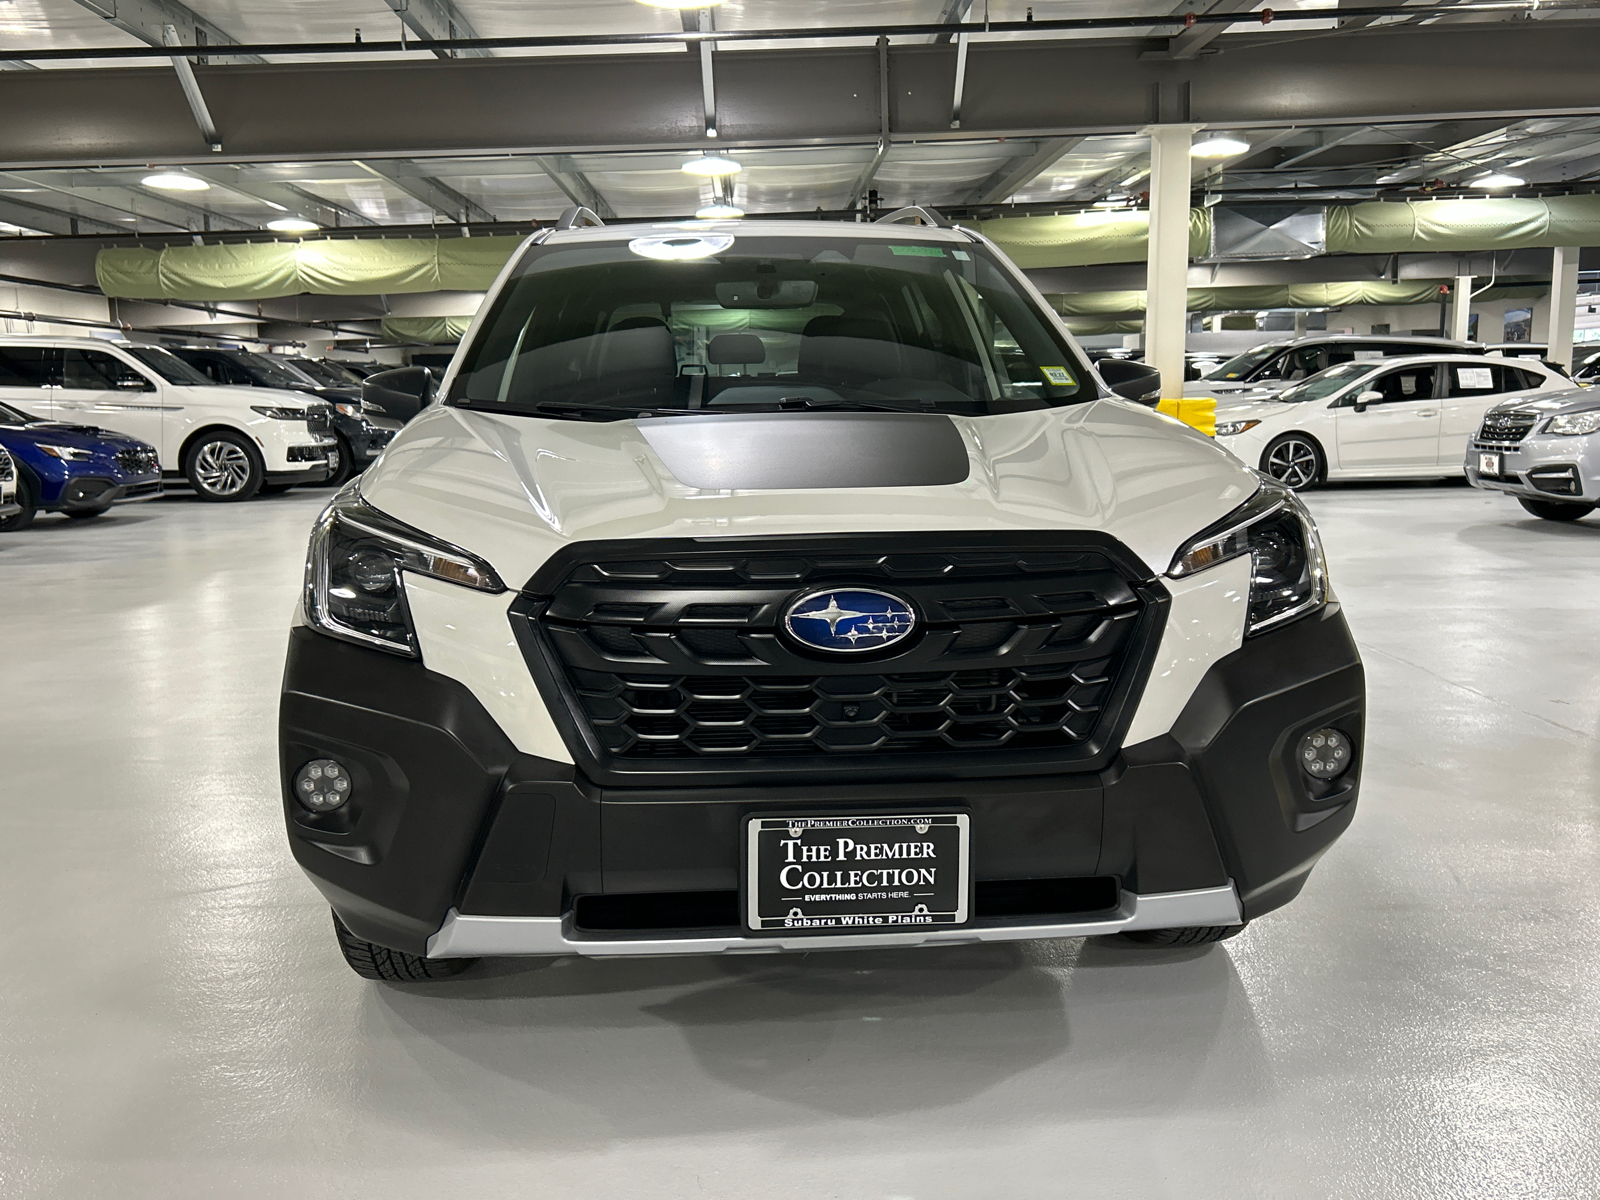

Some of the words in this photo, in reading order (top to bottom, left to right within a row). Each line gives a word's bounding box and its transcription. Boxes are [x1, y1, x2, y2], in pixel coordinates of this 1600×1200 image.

[804, 893, 857, 902] EVERYTHING
[857, 891, 887, 900] STARTS
[888, 891, 911, 899] HERE.
[784, 918, 836, 928] Subaru
[841, 916, 883, 925] White
[888, 914, 933, 924] Plains
